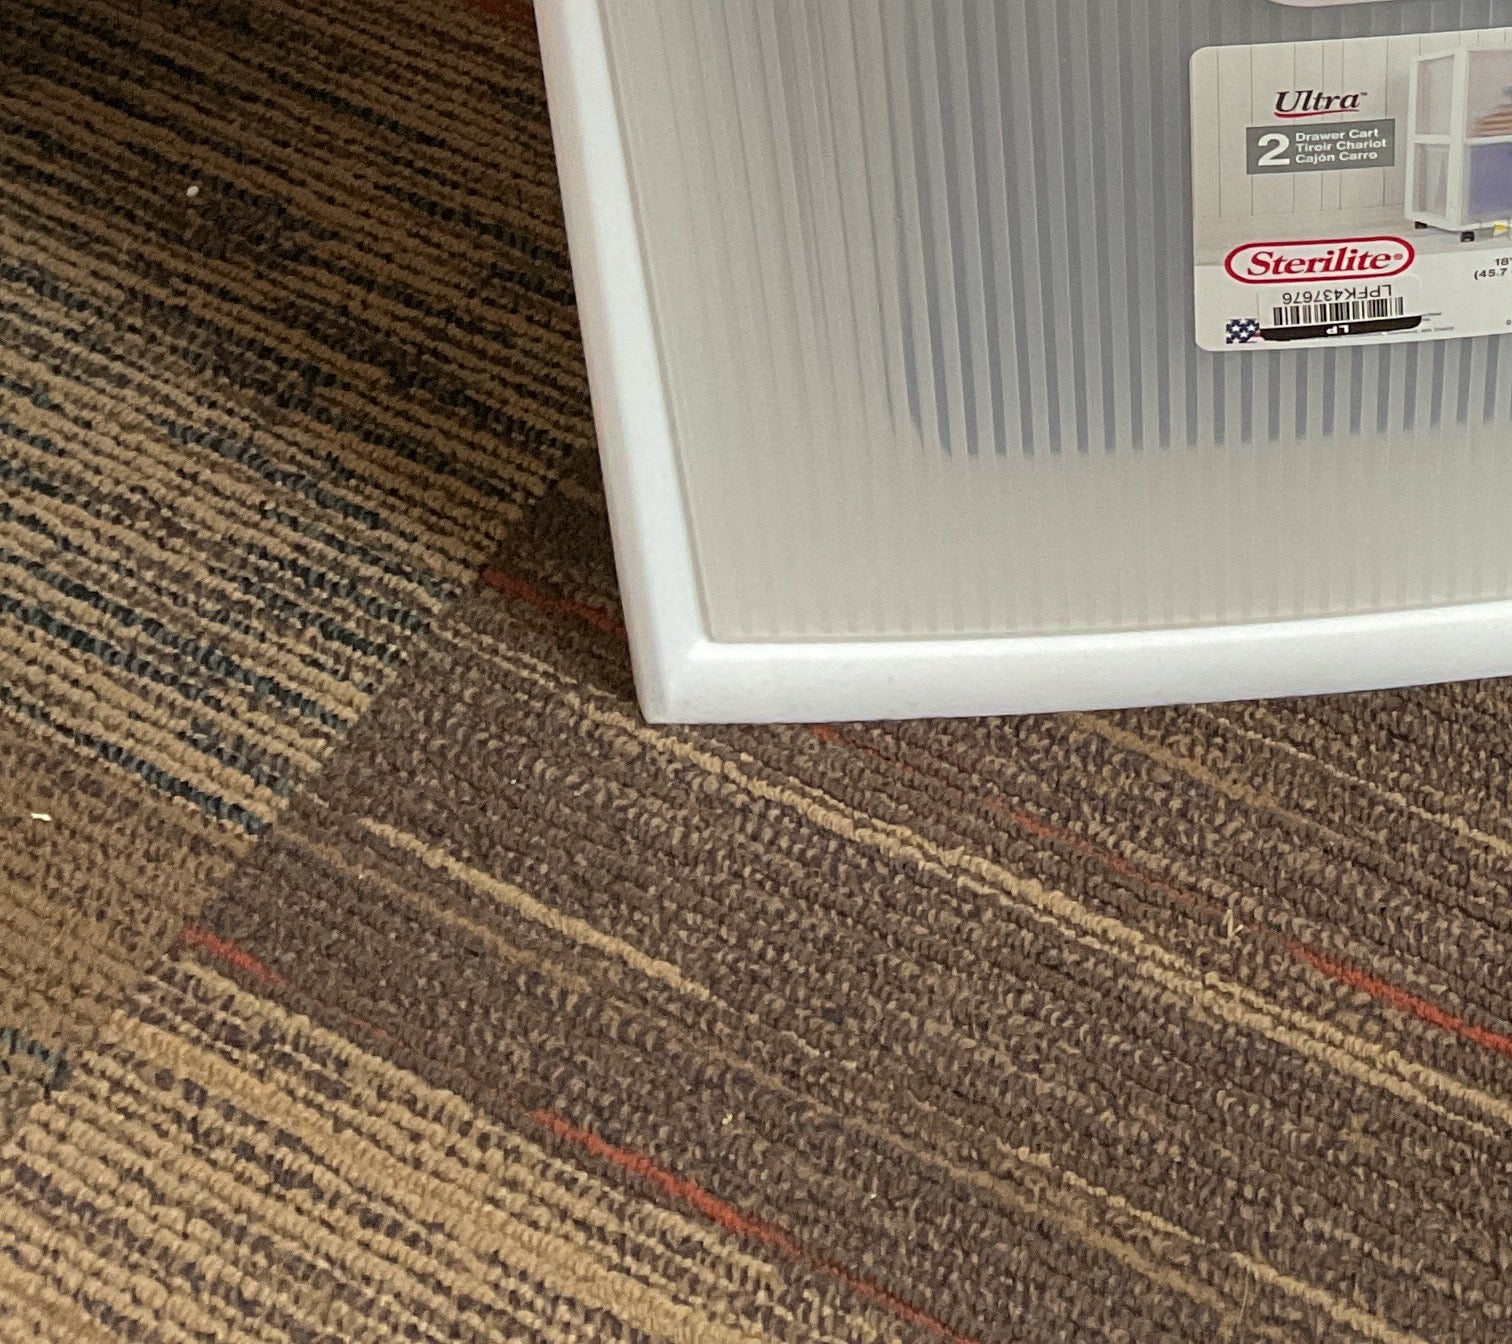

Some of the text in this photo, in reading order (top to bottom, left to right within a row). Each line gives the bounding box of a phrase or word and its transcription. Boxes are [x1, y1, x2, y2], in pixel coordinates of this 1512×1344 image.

[1295, 128, 1379, 142] Drawer Cart
[1258, 133, 1290, 166] 2
[1296, 138, 1387, 153] Tiroir Chariot
[1295, 150, 1378, 165] Cajón Carro
[1247, 247, 1392, 276] Sterilite
[1282, 284, 1392, 305] LPFK437676
[1326, 324, 1350, 335] LP
